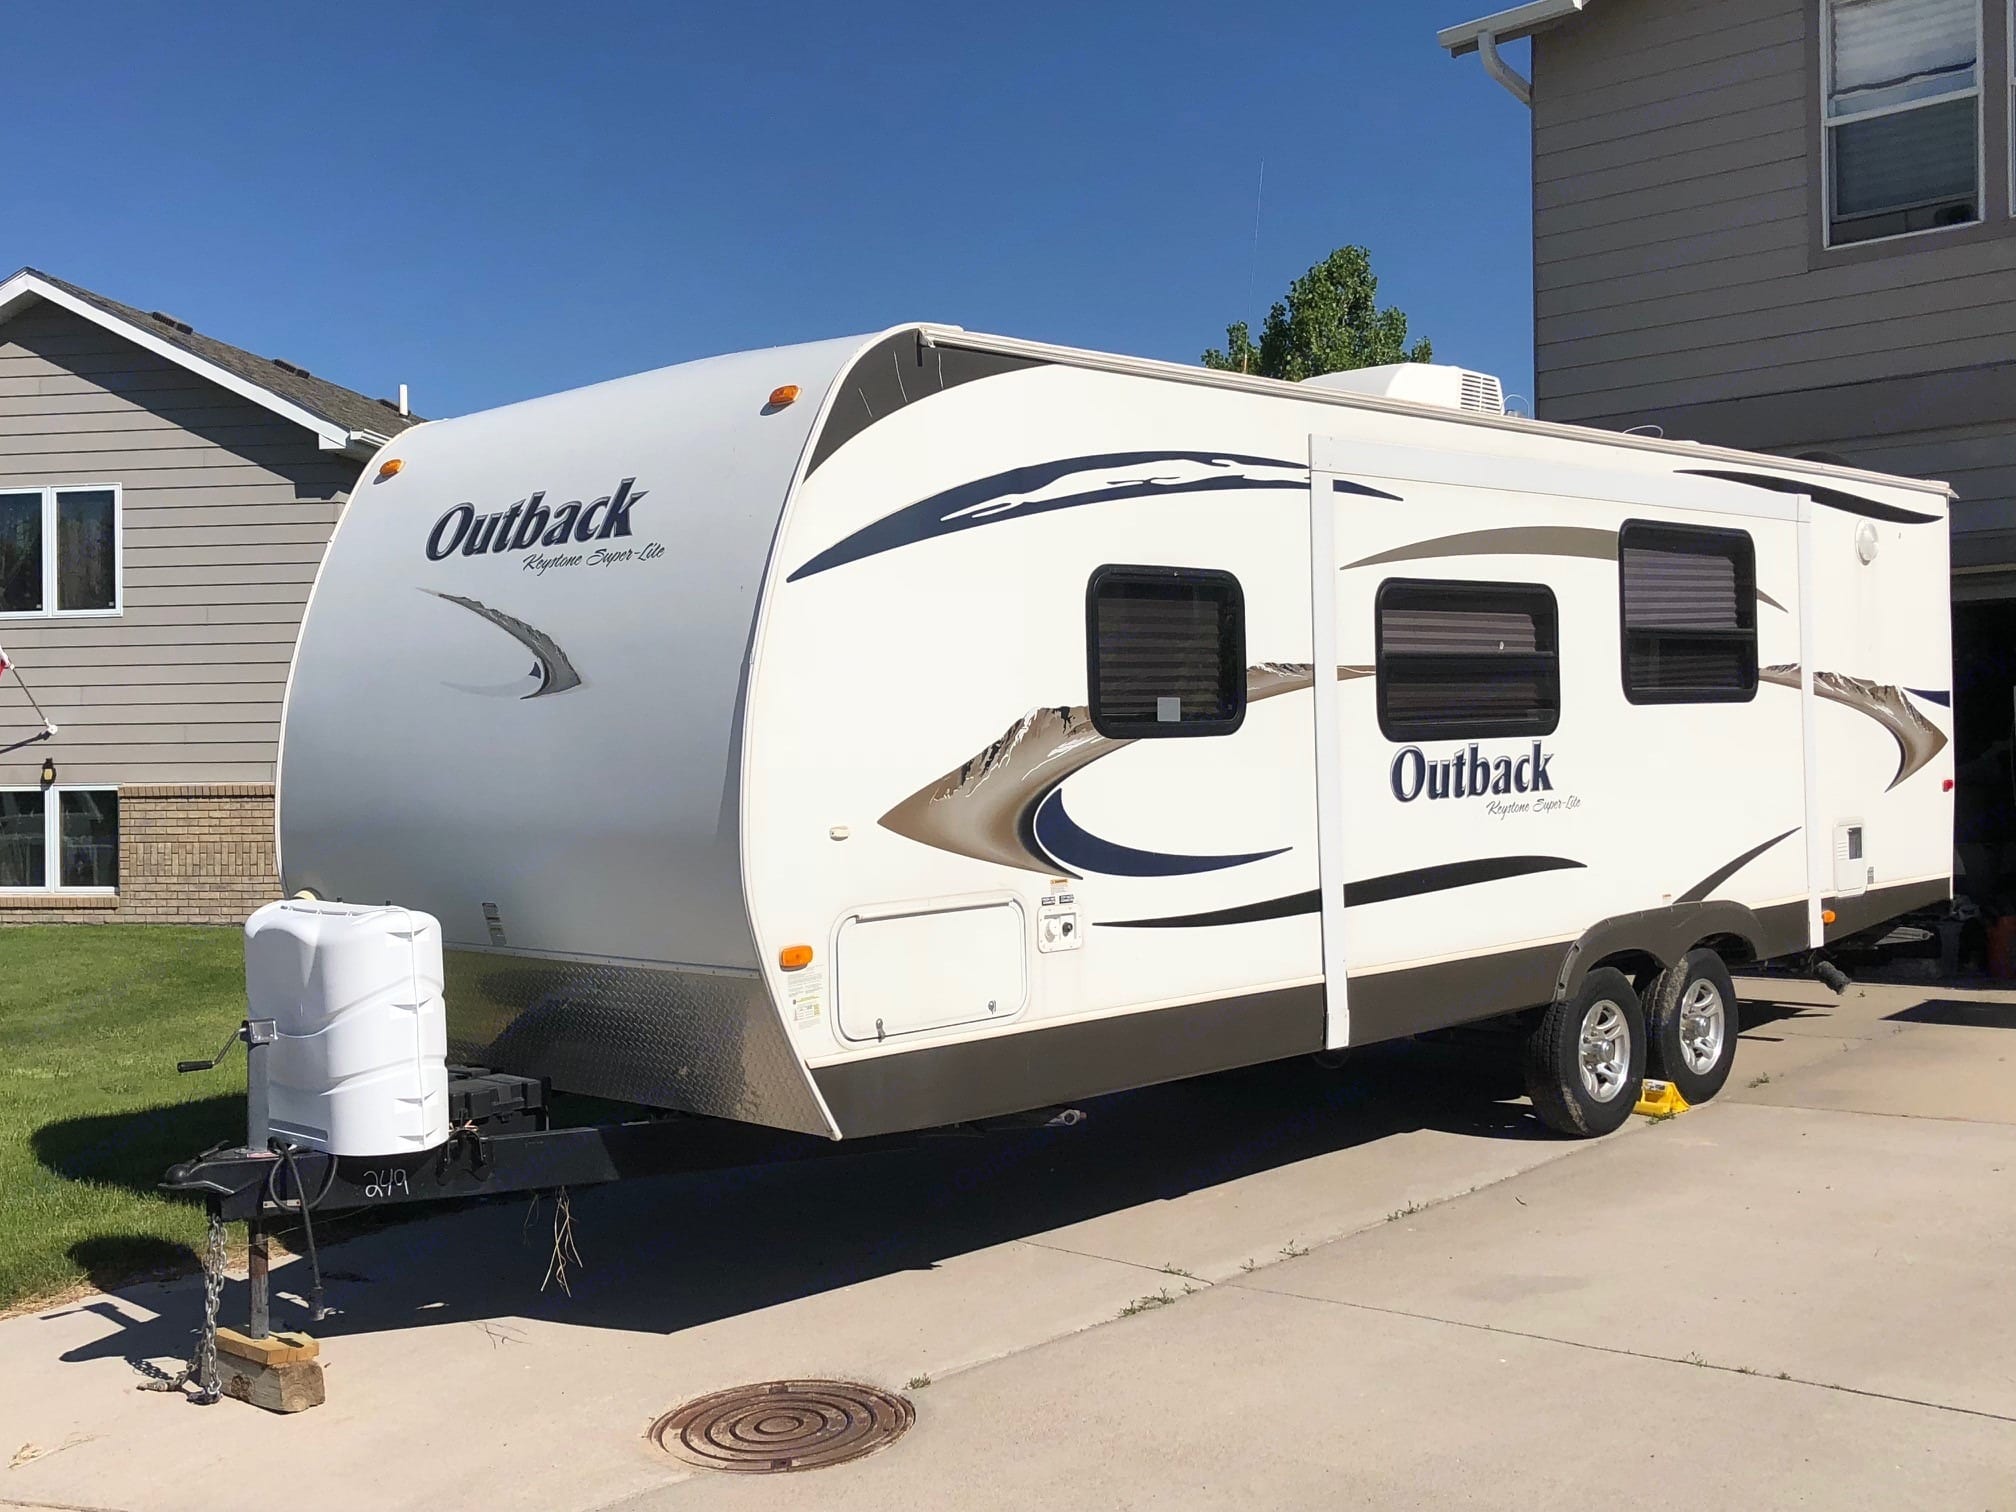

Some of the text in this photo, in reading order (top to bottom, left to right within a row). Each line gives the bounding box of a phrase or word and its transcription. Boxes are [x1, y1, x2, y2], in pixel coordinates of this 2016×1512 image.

[425, 477, 649, 561] Outback
[522, 543, 665, 576] Keystone Super-Lite
[1390, 740, 1554, 803] Outback
[1486, 800, 1530, 820] Keystone
[363, 1168, 410, 1198] 249
